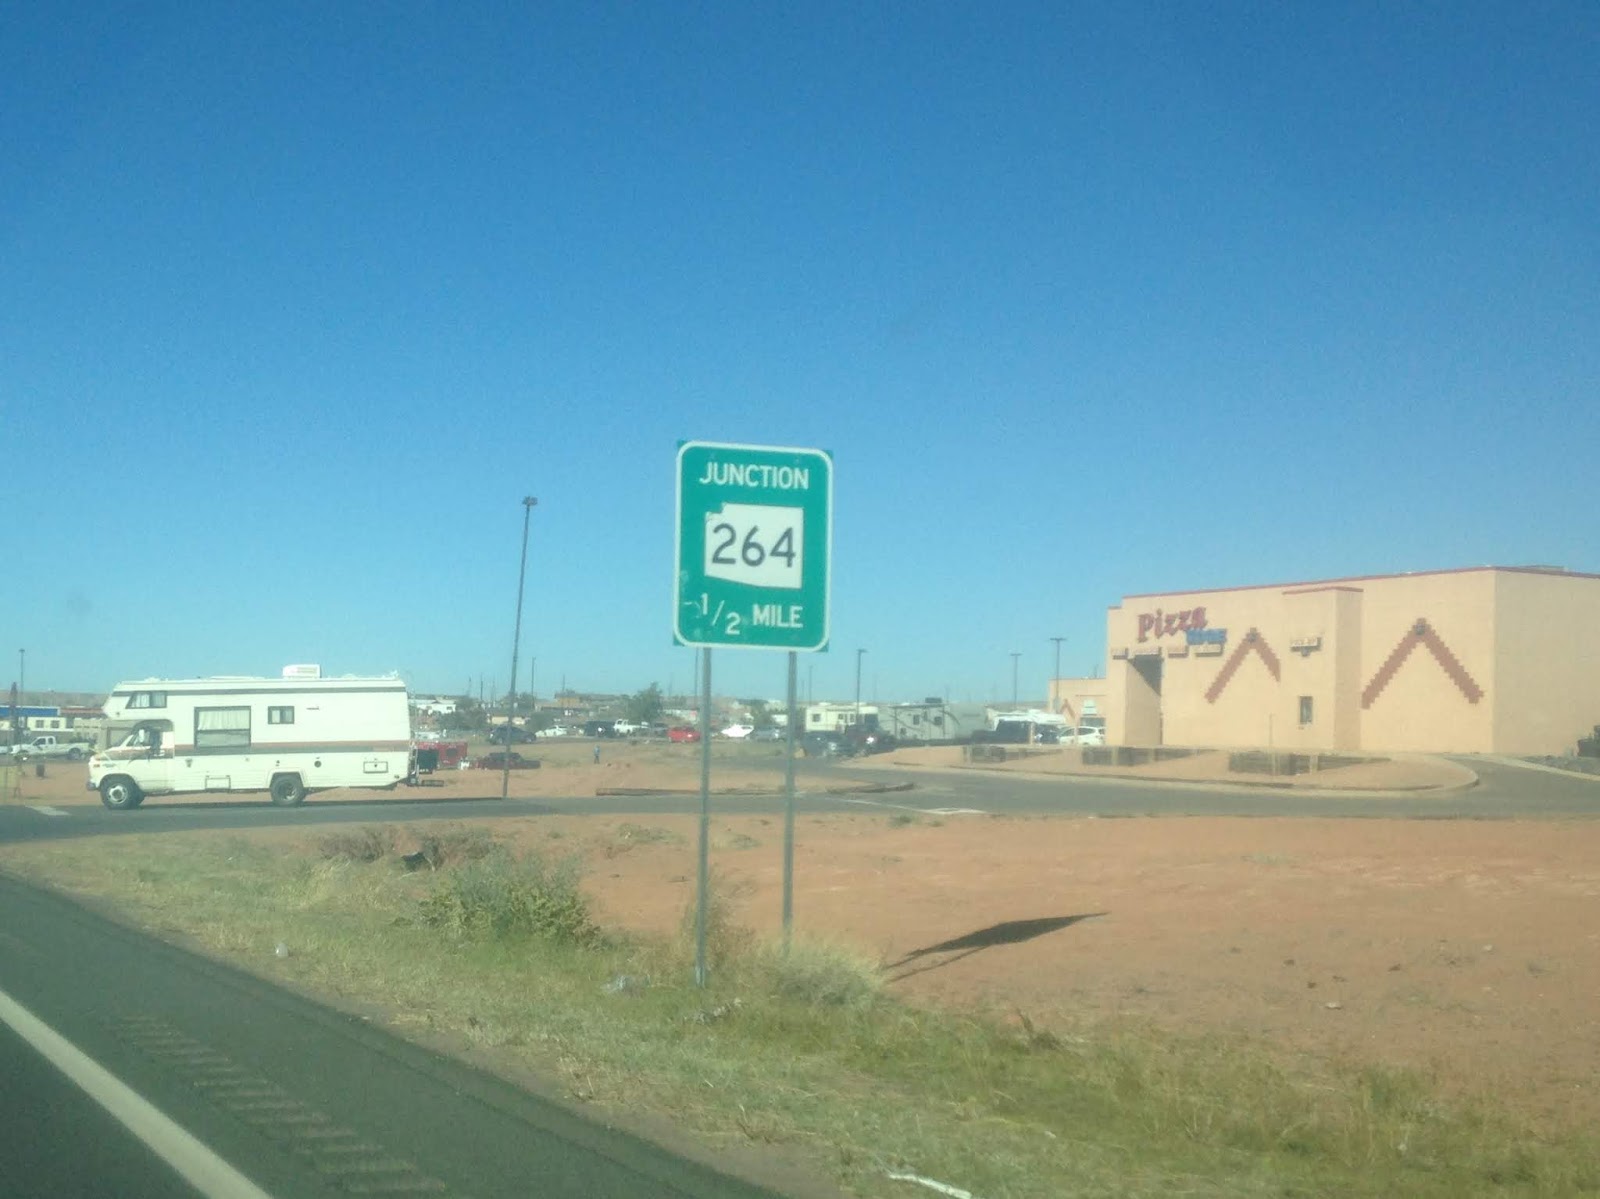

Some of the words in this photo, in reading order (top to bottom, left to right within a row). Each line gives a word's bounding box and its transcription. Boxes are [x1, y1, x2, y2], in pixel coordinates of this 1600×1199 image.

[700, 462, 809, 489] JUNCTION
[712, 523, 796, 567] 264
[701, 592, 741, 635] 1/2
[752, 603, 804, 628] MILE
